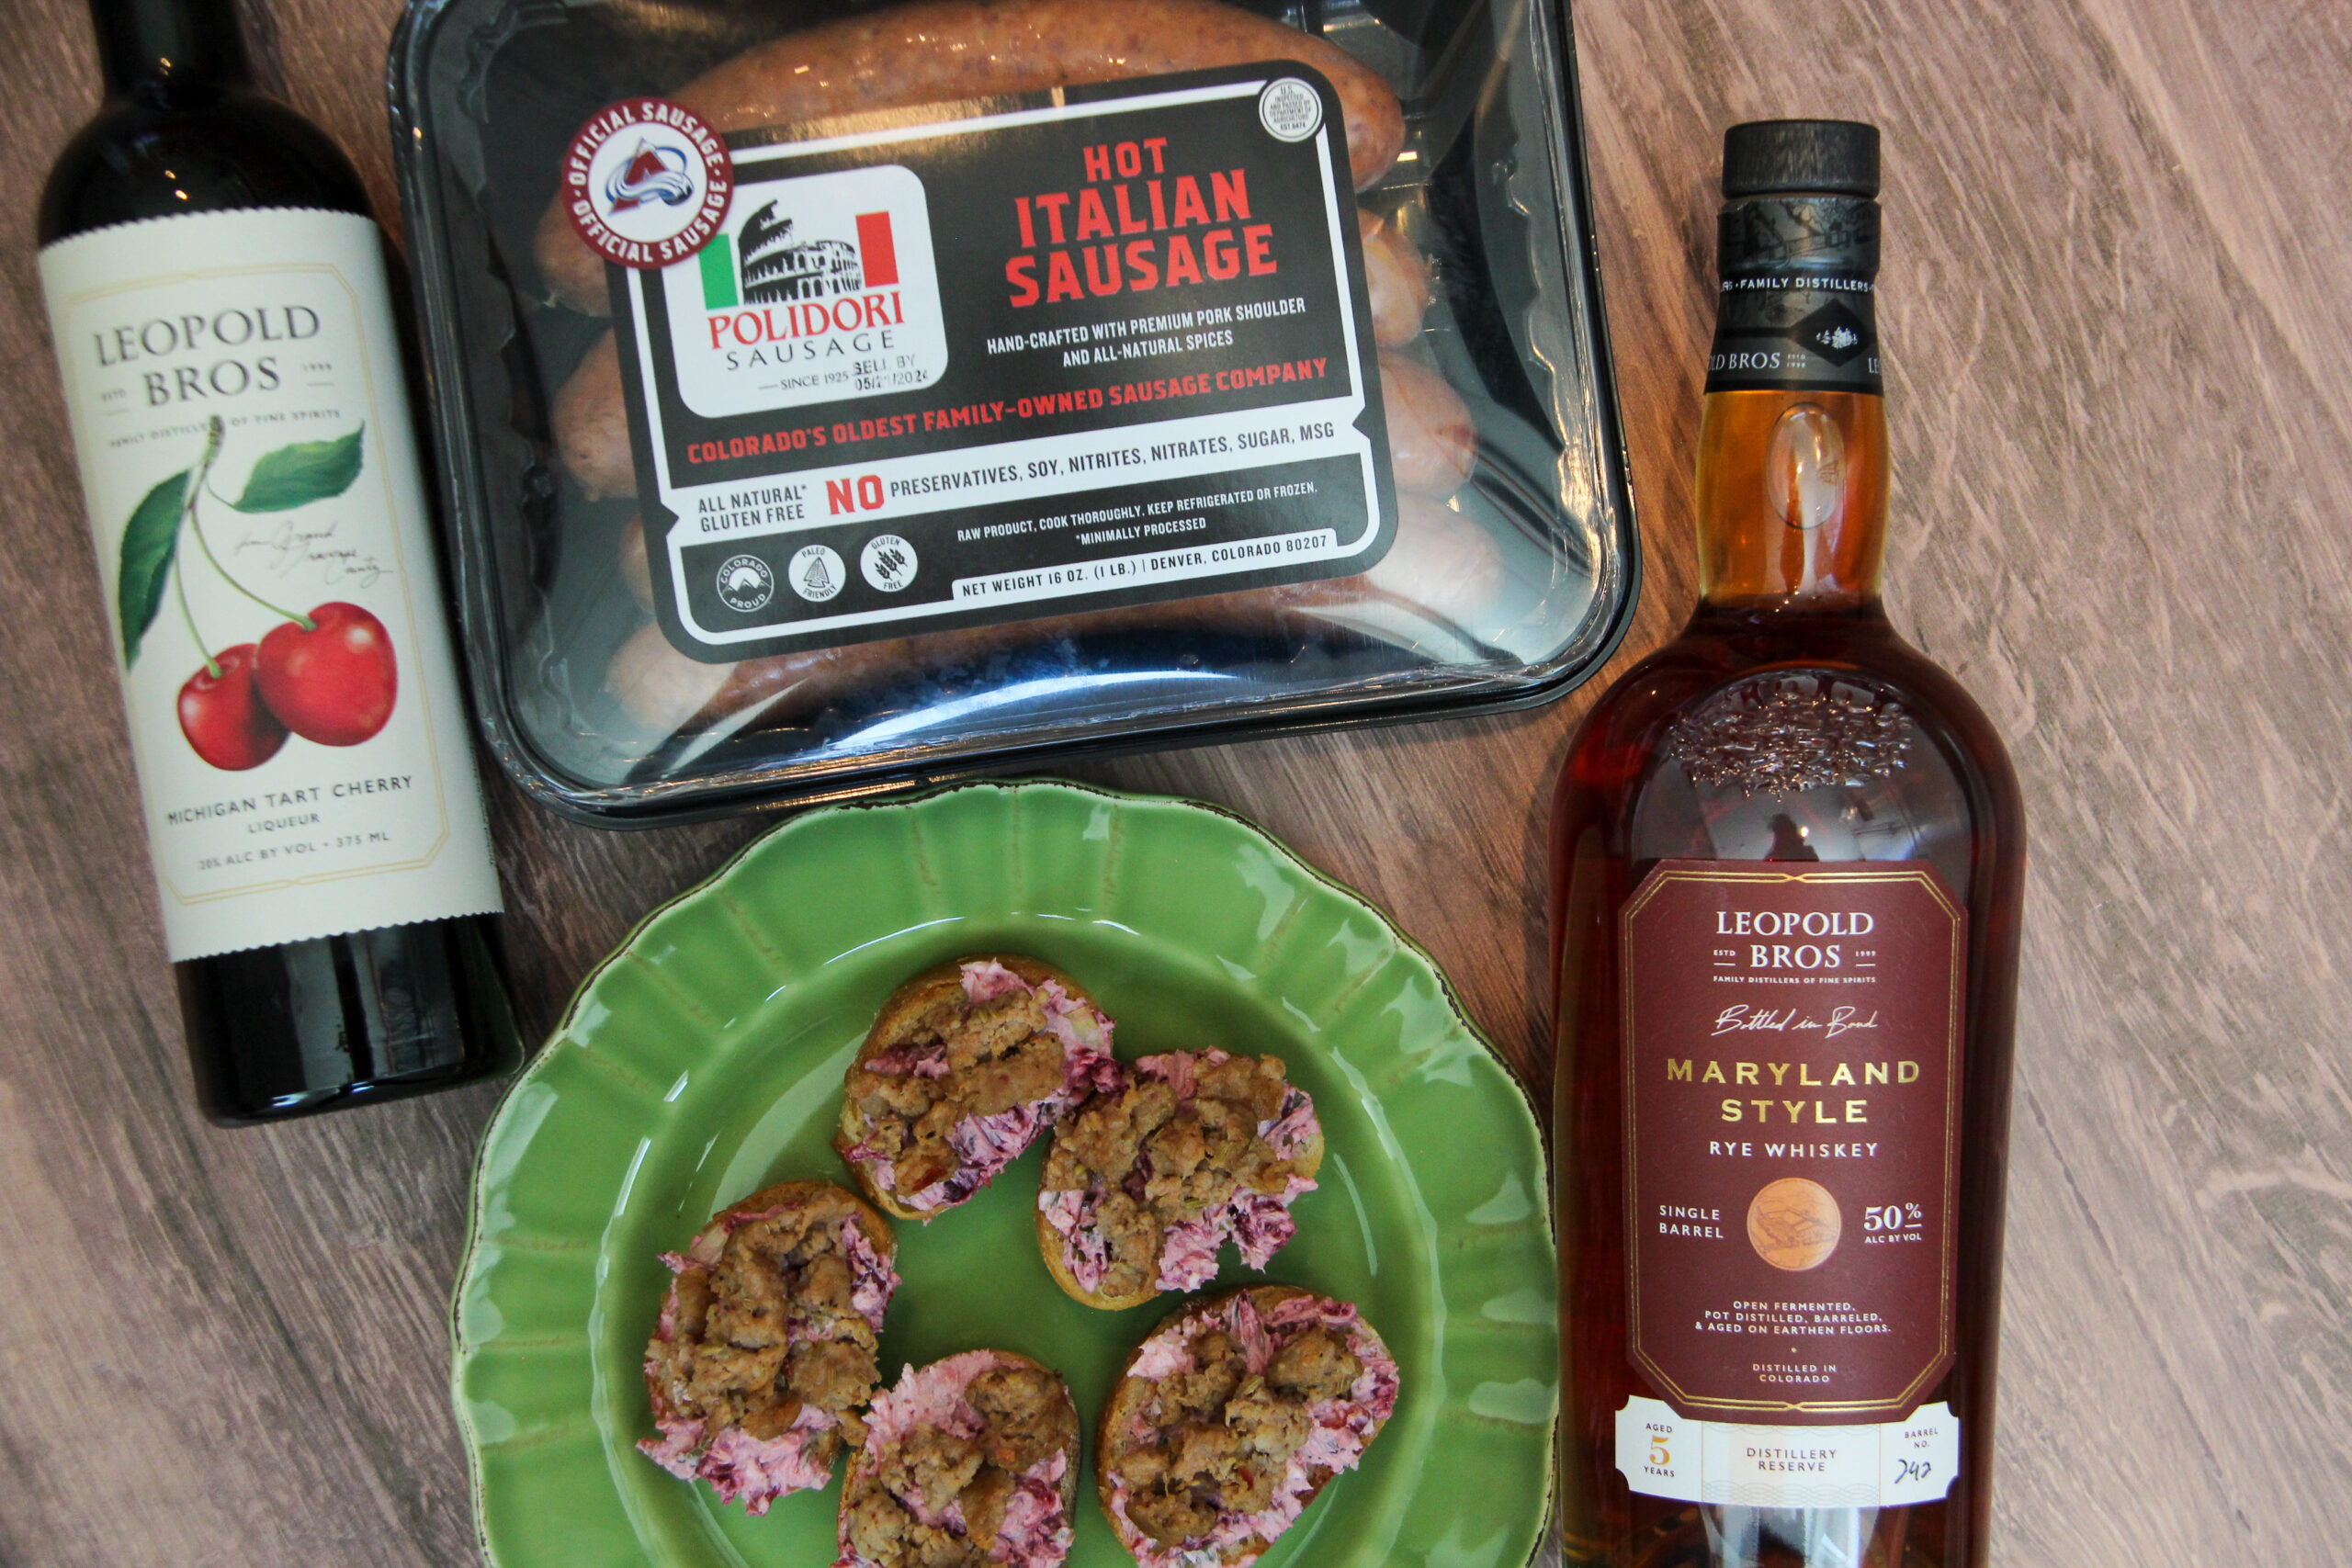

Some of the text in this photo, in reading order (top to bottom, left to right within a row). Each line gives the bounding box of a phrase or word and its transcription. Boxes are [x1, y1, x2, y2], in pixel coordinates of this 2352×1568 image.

[569, 102, 724, 186] OFFICIAL SAUSAGE
[1083, 137, 1168, 182] HOT
[1014, 169, 1251, 248] ITALIAN
[573, 180, 727, 263] OFFICIAL SAUSAGE
[1005, 223, 1277, 308] SAUSAGE
[1740, 277, 1789, 290] FAMILY
[1795, 277, 1869, 292] DISTILLERS
[707, 291, 905, 349] POLIDORI
[987, 298, 1306, 355] HAND-CRAFTED WITH PREMIUM PORK SHOULDER
[93, 306, 320, 367] LEOPOLD
[727, 330, 895, 371] SAUSAGE
[1062, 331, 1234, 367] AND ALL-NATURAL SPICES
[853, 354, 915, 376] SELL BY
[1728, 352, 1781, 369] BROS
[143, 356, 281, 406] BROS
[780, 371, 849, 389] SINCE 1925
[292, 409, 340, 420] SPIRITS
[687, 357, 1328, 463] COLORADO'S OLDEST FAMILY-OWNED SAUSAGE COMPANY
[825, 423, 1335, 515] NO PRESERVATIVES, SOY, NITRITES, NITRATES, SUGAR, MSG
[698, 495, 726, 513] ALL
[957, 481, 1318, 542] RAW PRODUCT, COOK THOROUGHLY. KEEP REFRIGERATED OR FROZEN.
[700, 504, 805, 533] GLUTEN FREE
[1143, 517, 1206, 536] PROCESSED
[801, 547, 827, 558] PALEO
[871, 536, 900, 550] GLUTEN
[719, 558, 769, 584] COLORADO
[962, 581, 987, 598] NET
[991, 573, 1043, 594] WEIGHT
[1047, 570, 1062, 585] 16
[1067, 567, 1090, 582] OZ.
[1093, 565, 1105, 581] (1
[1109, 560, 1136, 578] LB.)
[1211, 542, 1282, 563] COLORADO
[1286, 535, 1329, 553] 80207
[802, 584, 838, 599] FRIENDLY
[883, 581, 904, 591] FREE
[729, 592, 766, 609] PROUD
[168, 775, 413, 825] MICHIGAN TART CHERRY
[248, 813, 321, 834] LIQUEUR
[226, 851, 254, 866] ALC
[260, 847, 278, 860] BY
[285, 840, 316, 855] VOL
[336, 835, 363, 848] 375
[369, 831, 390, 843] ML
[1716, 911, 1874, 936] LEOPOLD
[1749, 944, 1841, 969] BROS
[1748, 976, 1800, 984] DISTILLERS
[1843, 976, 1876, 984] SPIRITS
[1711, 1004, 1879, 1039] Bottled in Bond
[1668, 1058, 1919, 1087] MARYLAND
[1721, 1099, 1868, 1124] STYLE
[1710, 1141, 1879, 1158] RYE WHISKEY
[1659, 1204, 1721, 1221] SINGLE
[1863, 1201, 1923, 1232] 50%
[1659, 1223, 1724, 1239] BARREL
[1864, 1233, 1922, 1244] ALC BY VOL
[1704, 1310, 1730, 1320] POT
[1733, 1301, 1768, 1311] OPEN
[1695, 1321, 1892, 1335] & AGED ON EARTHEN FLOORS.
[1752, 1363, 1837, 1373] DISTILLED IN
[1758, 1374, 1830, 1383] COLORADO
[1645, 1423, 1673, 1433] AGED
[1904, 1427, 1939, 1439] BARREL
[1649, 1435, 1670, 1465] 5
[1747, 1447, 1838, 1460] DISTILLERY
[1644, 1466, 1676, 1478] YEARS
[1758, 1461, 1826, 1472] RESERVE
